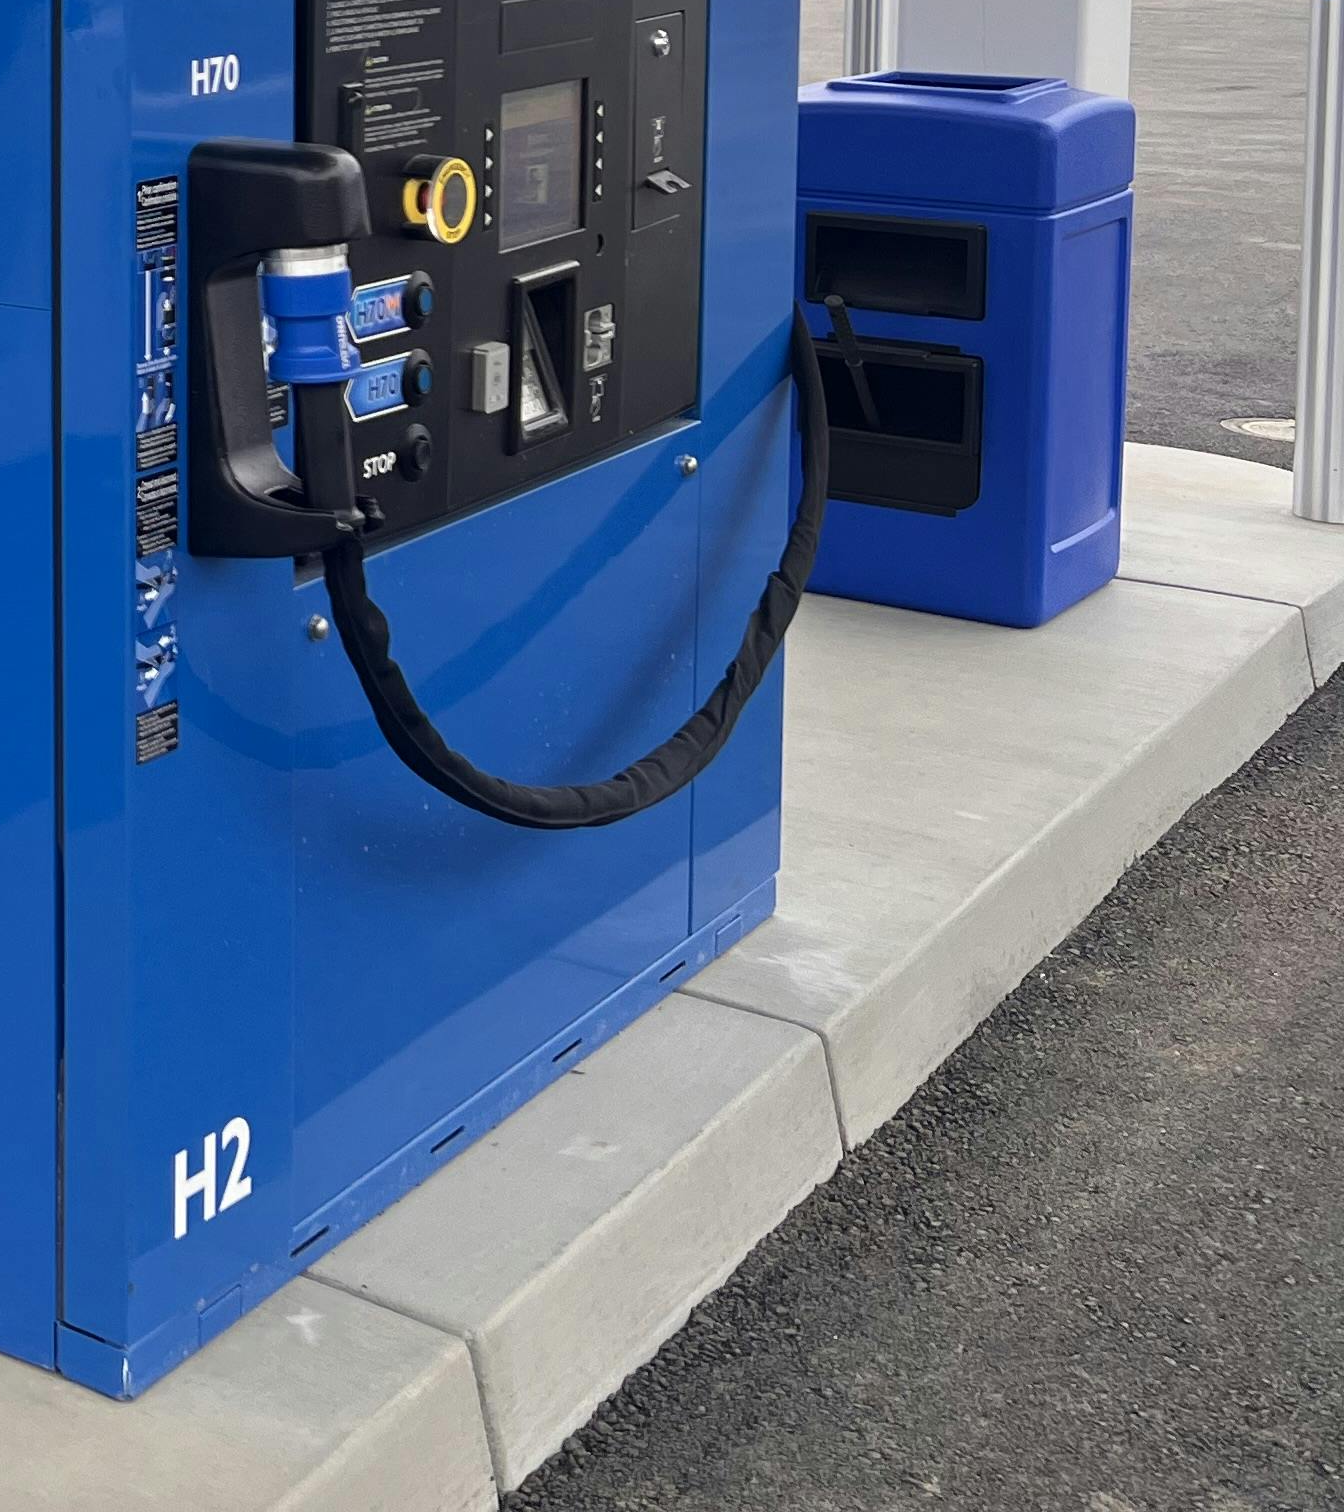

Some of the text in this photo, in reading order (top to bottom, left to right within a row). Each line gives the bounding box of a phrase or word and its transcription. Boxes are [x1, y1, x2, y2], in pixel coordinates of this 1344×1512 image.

[191, 53, 240, 97] H70
[367, 372, 400, 402] H70
[363, 451, 397, 479] STOP
[173, 1116, 253, 1240] H2
